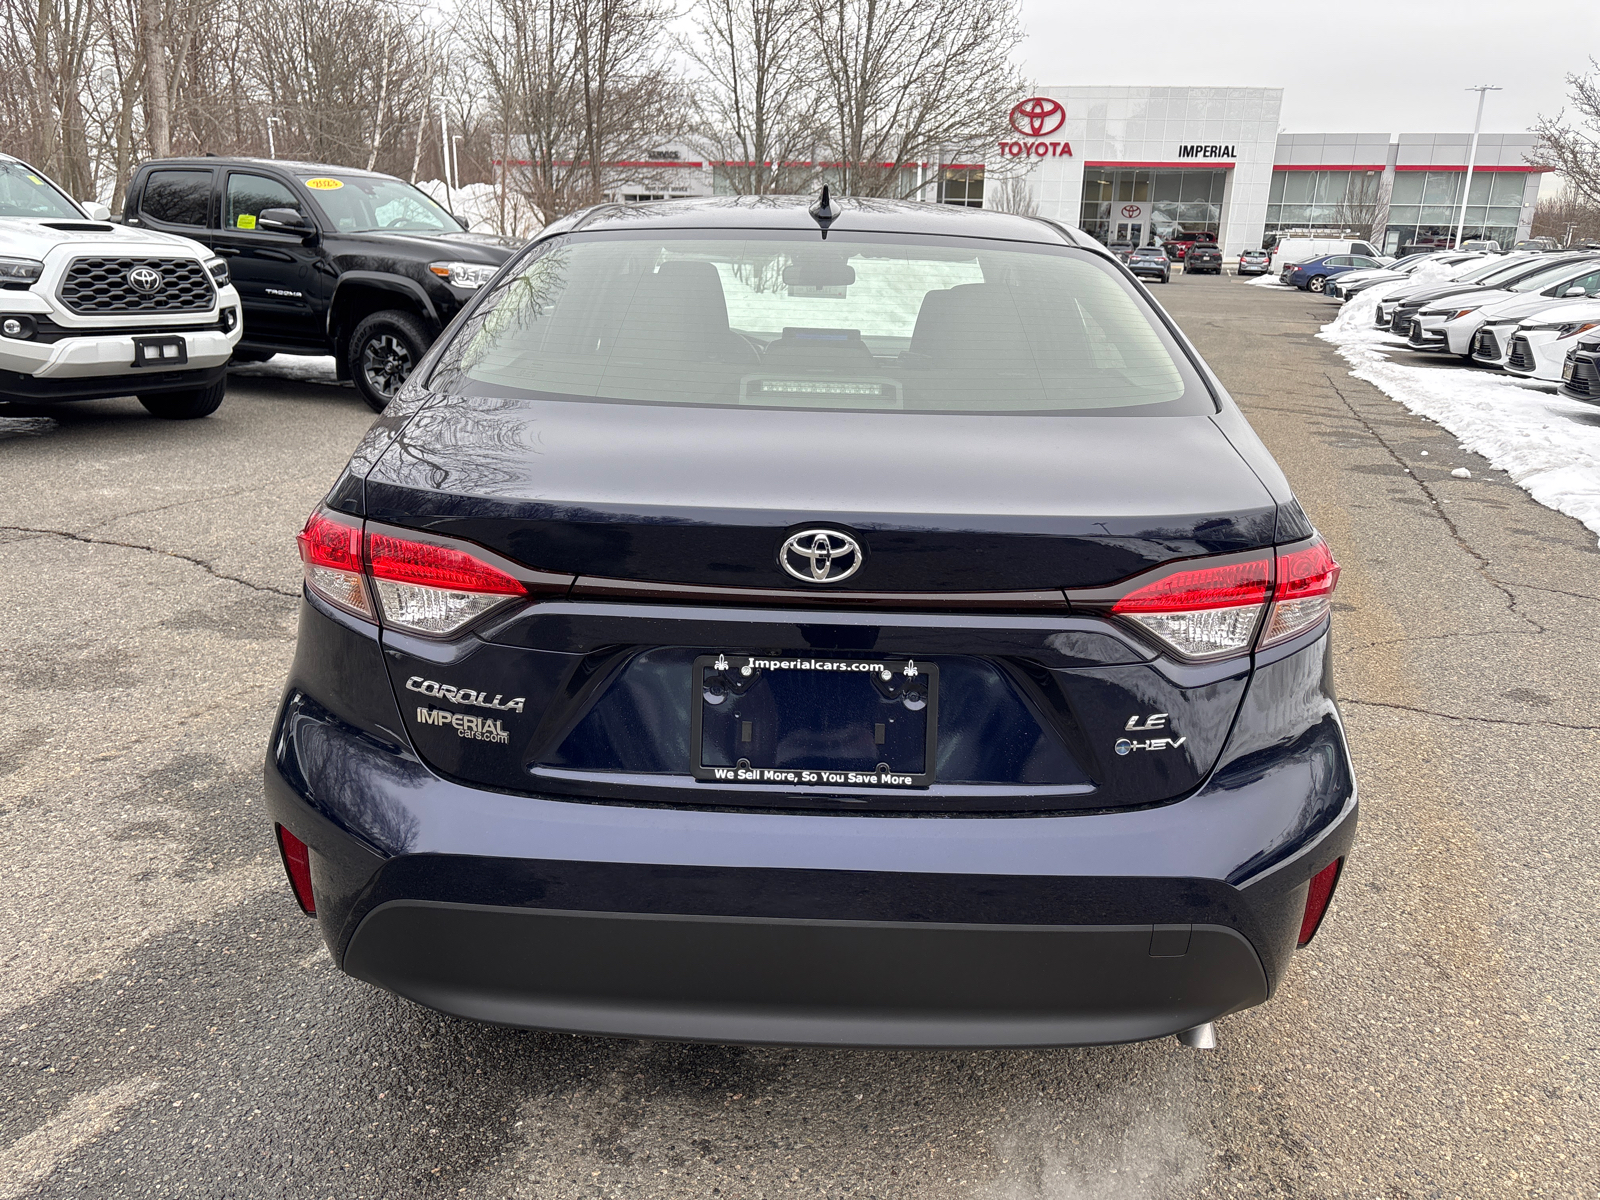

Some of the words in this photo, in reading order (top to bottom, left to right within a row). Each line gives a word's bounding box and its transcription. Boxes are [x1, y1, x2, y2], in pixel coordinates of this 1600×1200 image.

[997, 141, 1073, 157] TOYOTA
[1178, 144, 1237, 158] IMPERIAL
[264, 288, 303, 298] TACOMA
[748, 657, 885, 673] Imperialcars.com
[405, 675, 526, 714] COROLLA
[416, 706, 510, 737] IMPERIAL
[1124, 713, 1169, 731] LE
[457, 728, 510, 745] cars.com
[714, 768, 735, 780] We
[737, 768, 760, 781] Sell
[763, 770, 798, 783] More,
[801, 771, 818, 782] So
[820, 771, 845, 783] You
[847, 772, 878, 784] Save
[881, 773, 912, 785] More
